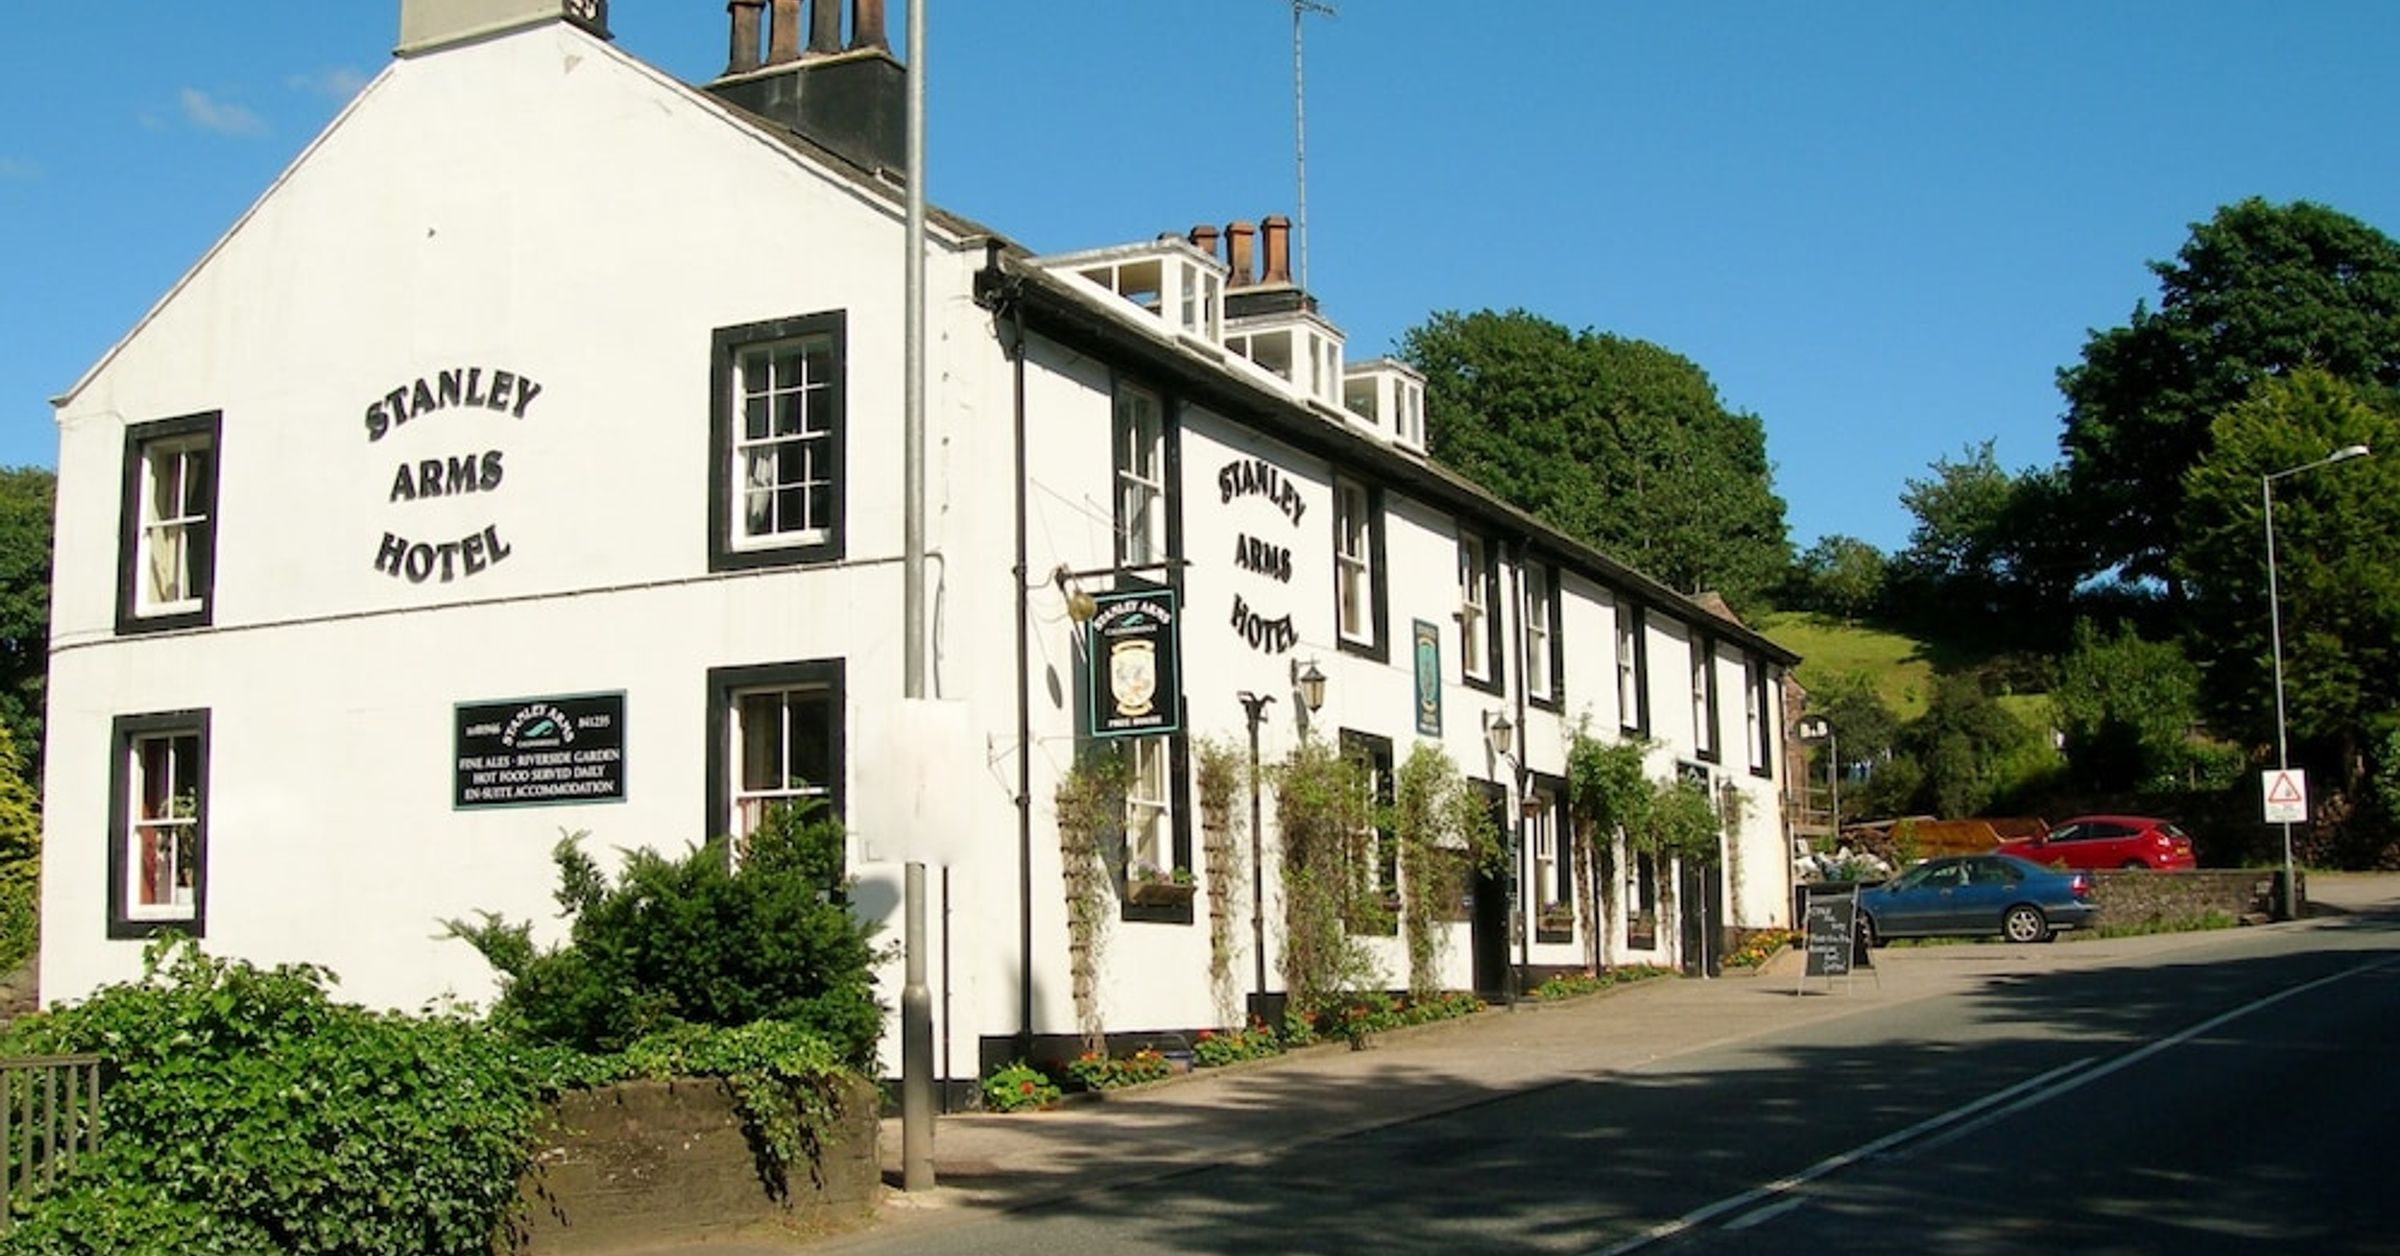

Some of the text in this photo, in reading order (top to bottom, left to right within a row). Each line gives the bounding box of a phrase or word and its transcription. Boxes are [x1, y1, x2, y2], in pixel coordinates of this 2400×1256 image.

[365, 366, 542, 442] STANLEY
[389, 449, 503, 502] ARMS
[1219, 459, 1307, 528] STANLEY
[374, 523, 511, 584] HOTEL
[1234, 532, 1292, 584] ARMS
[1093, 600, 1139, 632] STANLEY
[1139, 601, 1172, 625] ARMS
[1230, 592, 1299, 655] HOTEL
[502, 704, 549, 747] STANLEY
[547, 707, 575, 743] ARMS
[459, 748, 620, 770] FINE ALES RIVERSIDE GARDEN
[473, 765, 606, 785] HOT FOOD SERVED DAILY
[464, 780, 615, 801] EN-SUITE ACCOMMODATION
